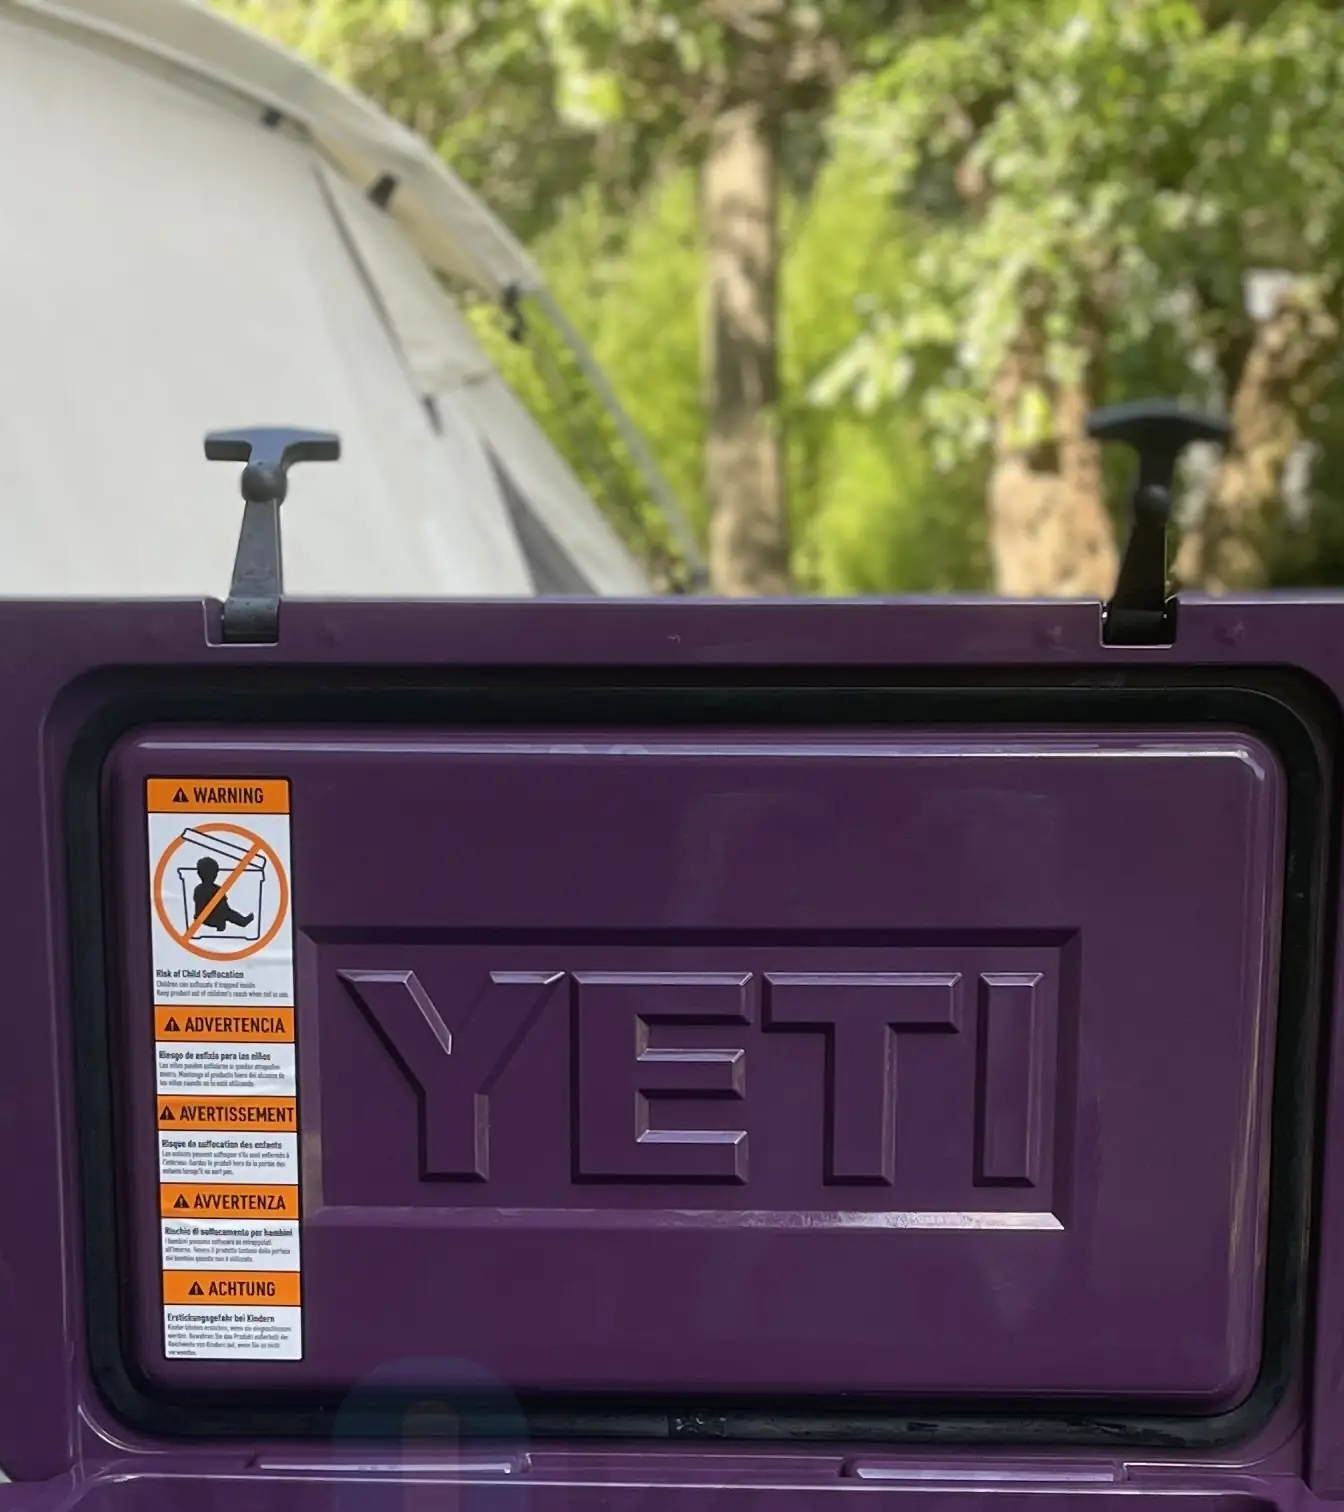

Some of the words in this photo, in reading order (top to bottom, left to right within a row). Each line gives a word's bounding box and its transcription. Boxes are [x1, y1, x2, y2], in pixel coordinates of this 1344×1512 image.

[193, 787, 264, 804] WARNING
[156, 969, 172, 978] Risk
[184, 1017, 285, 1033] ADVERTENCIA
[336, 968, 1045, 1188] YETI
[179, 1106, 295, 1122] AVERTISSEMENT
[193, 1193, 286, 1210] AVVERTENZA
[208, 1281, 276, 1297] ACHTUNG
